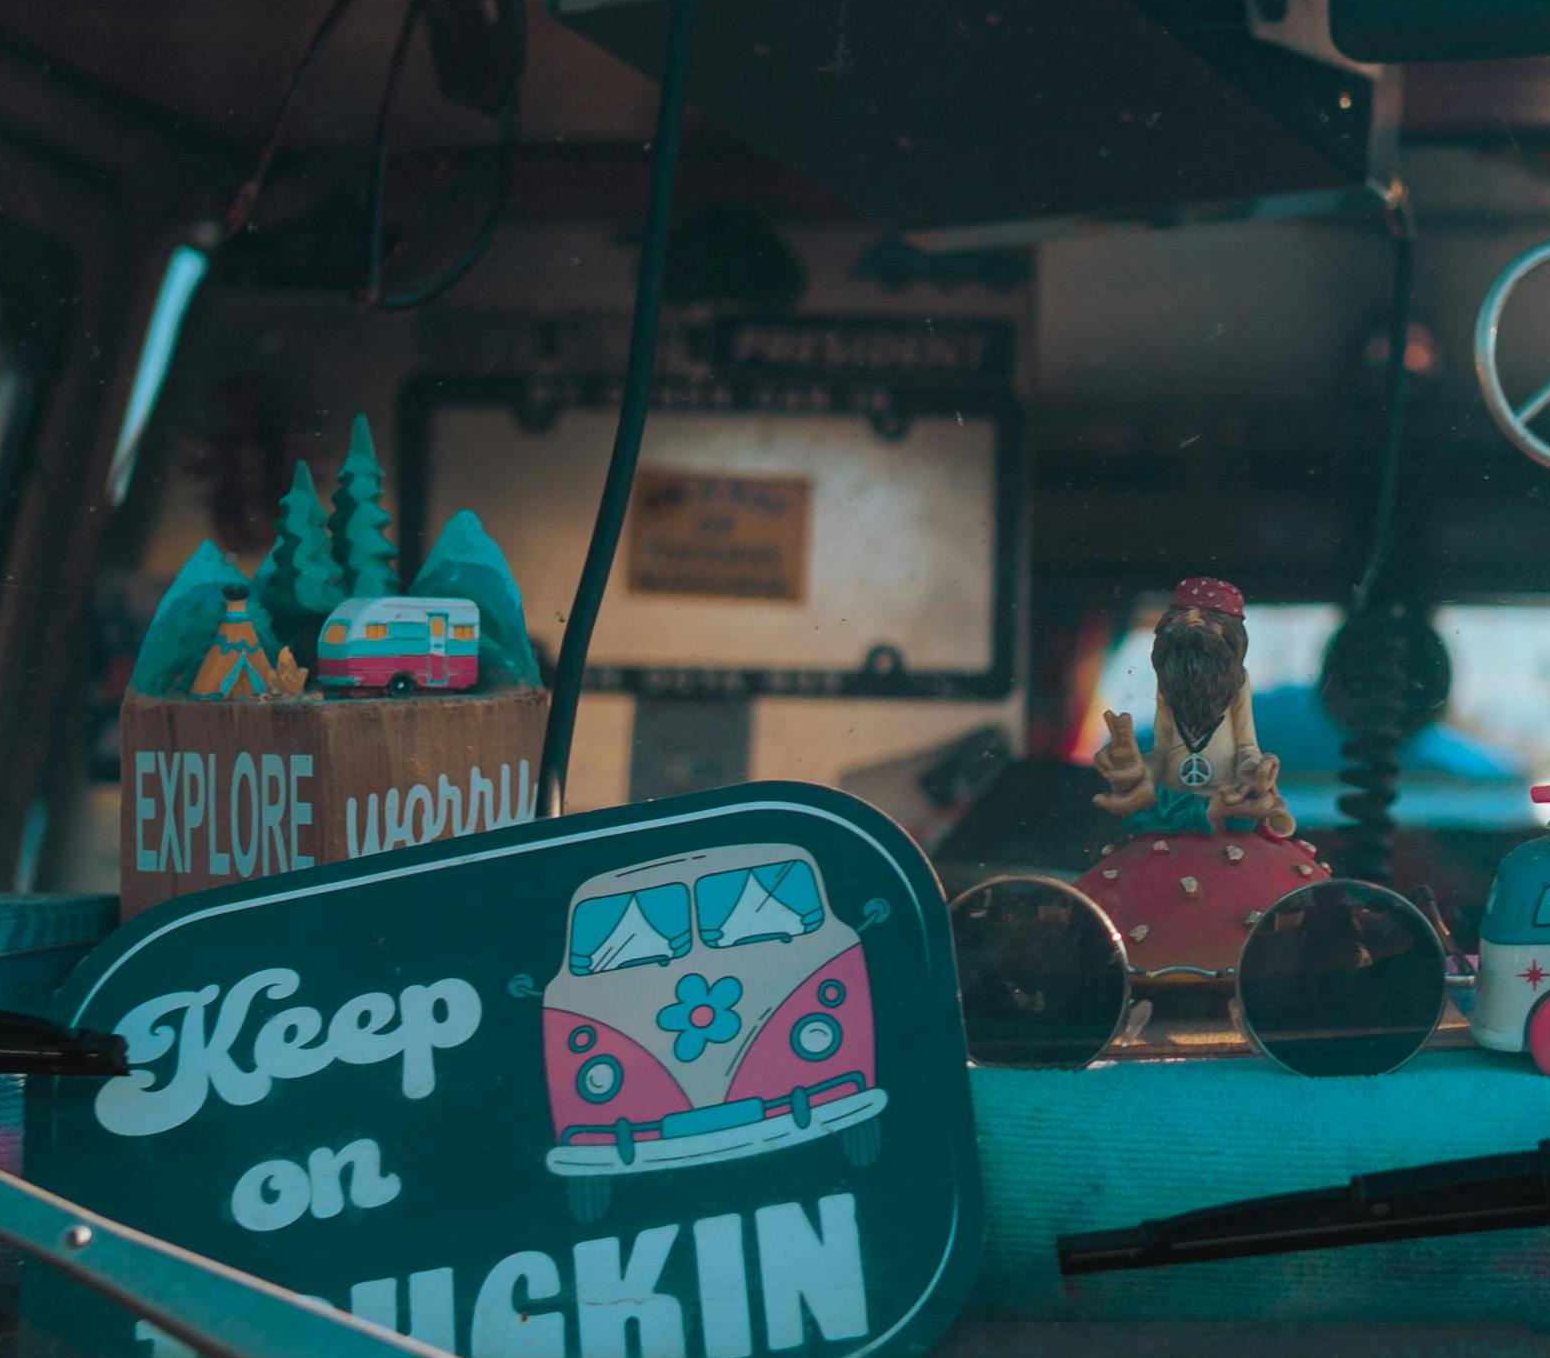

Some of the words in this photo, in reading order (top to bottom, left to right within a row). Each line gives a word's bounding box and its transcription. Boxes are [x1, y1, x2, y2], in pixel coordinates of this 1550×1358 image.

[135, 750, 315, 879] EXPLORE
[94, 967, 482, 1136] Keep
[231, 1138, 401, 1232] on
